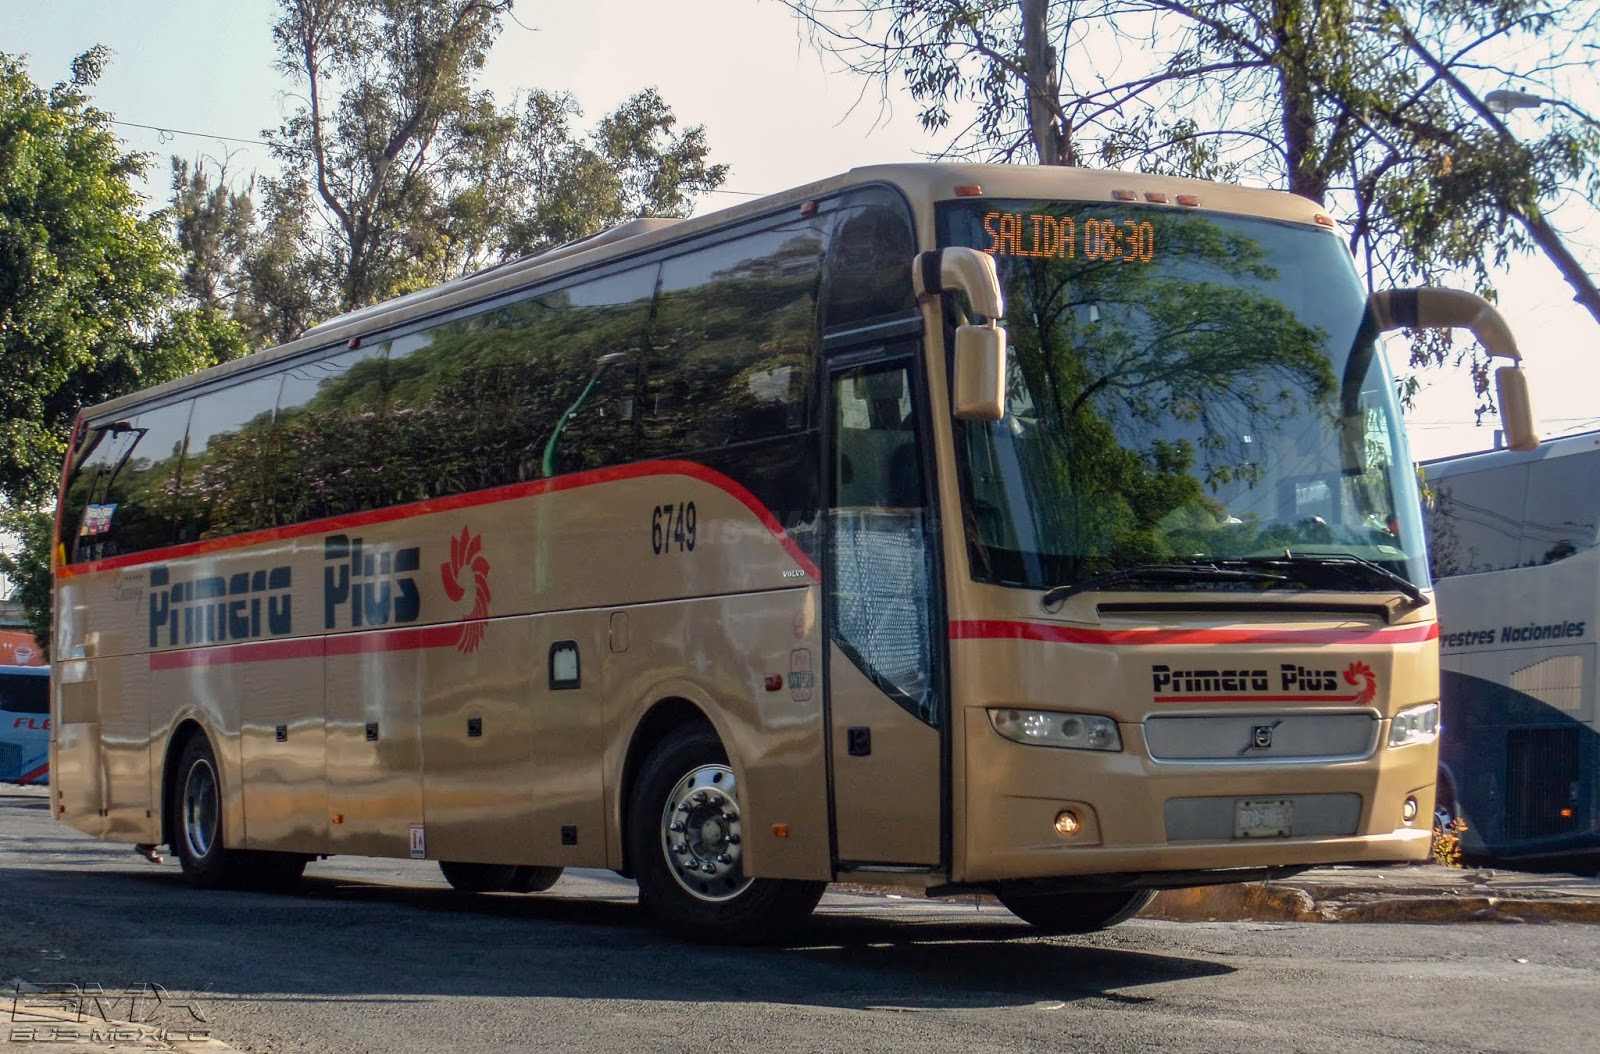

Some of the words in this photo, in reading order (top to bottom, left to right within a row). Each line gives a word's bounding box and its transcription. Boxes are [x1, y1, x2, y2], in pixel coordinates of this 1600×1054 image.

[984, 212, 1075, 260] SALIDA
[1084, 218, 1154, 263] 08:30
[652, 501, 697, 555] 6749
[150, 565, 292, 647] Primera
[324, 534, 420, 629] Plus
[782, 569, 805, 578] VOLVO
[1439, 629, 1496, 648] restres
[1501, 620, 1586, 643] Nacionales
[1152, 664, 1269, 692] Primera
[1280, 664, 1338, 691] Plus
